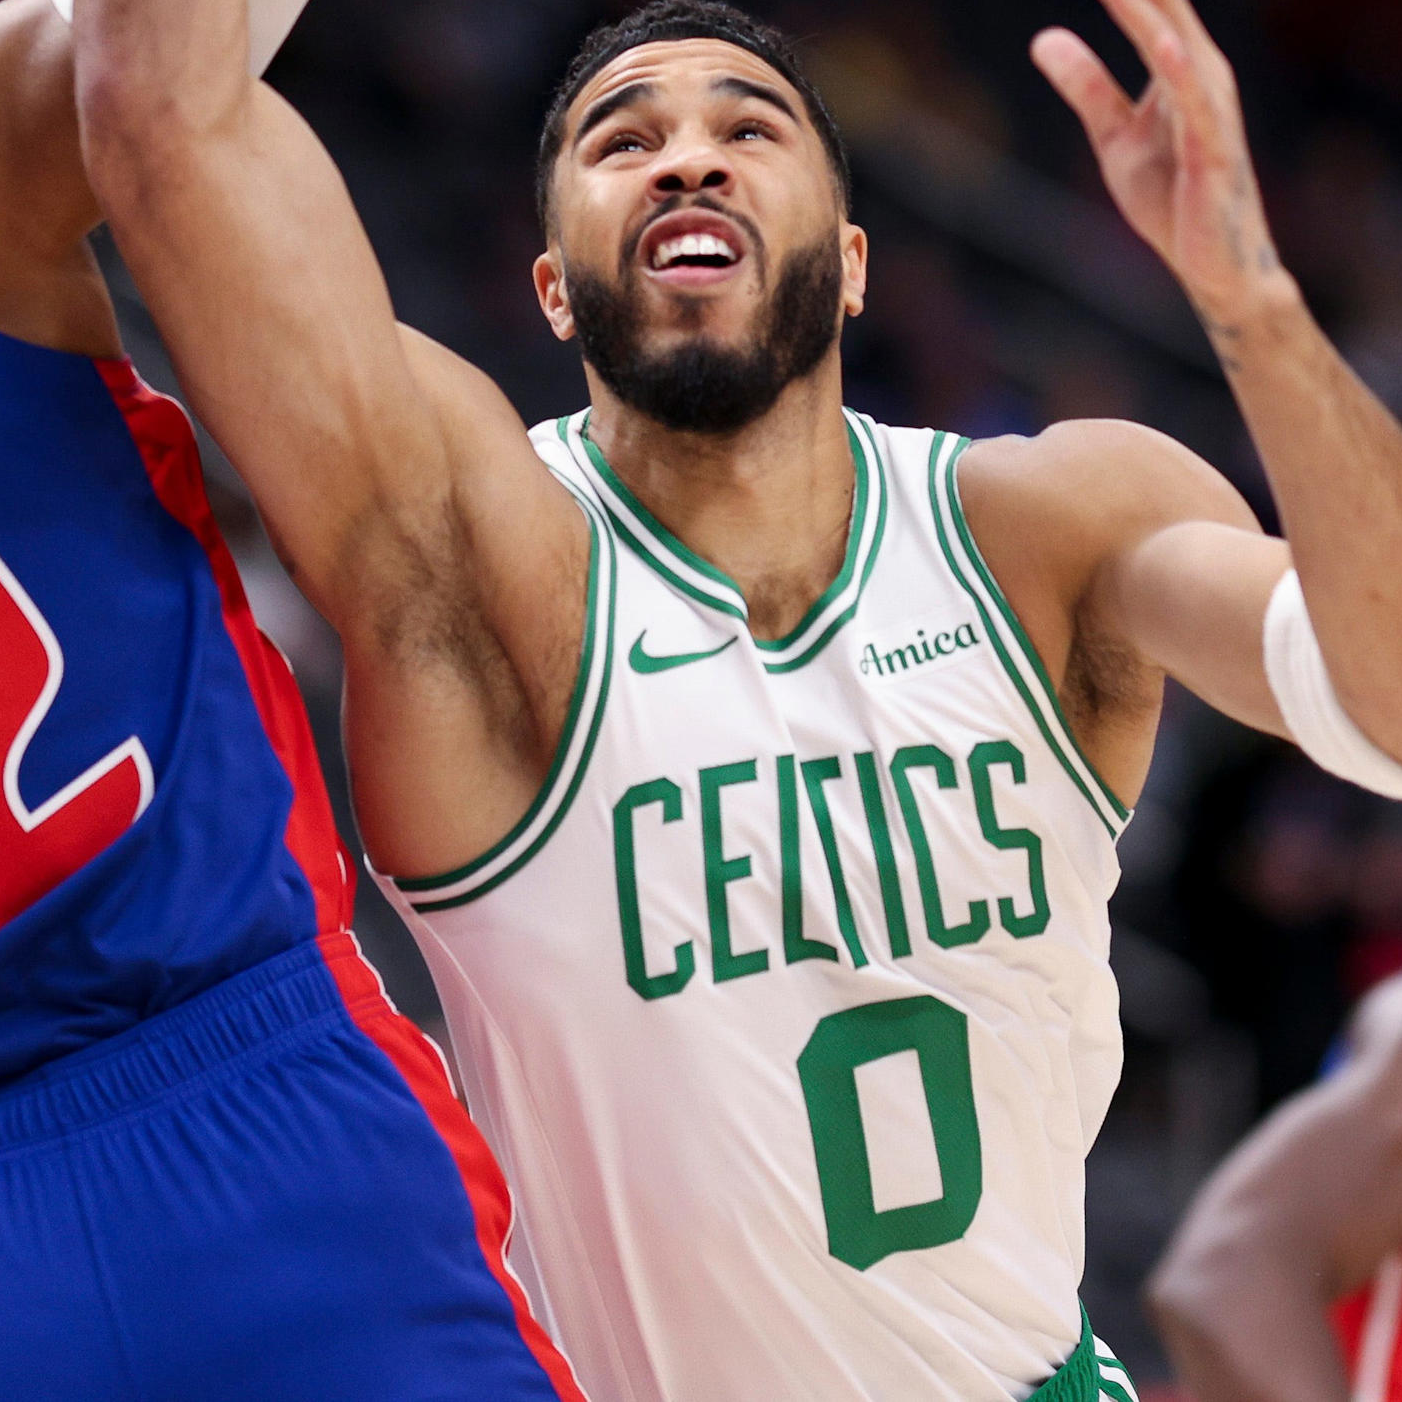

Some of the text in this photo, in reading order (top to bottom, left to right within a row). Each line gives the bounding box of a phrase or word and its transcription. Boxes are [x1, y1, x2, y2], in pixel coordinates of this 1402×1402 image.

[859, 622, 981, 676] Amica
[612, 740, 1051, 1001] CELTICS
[796, 994, 983, 1272] 0
